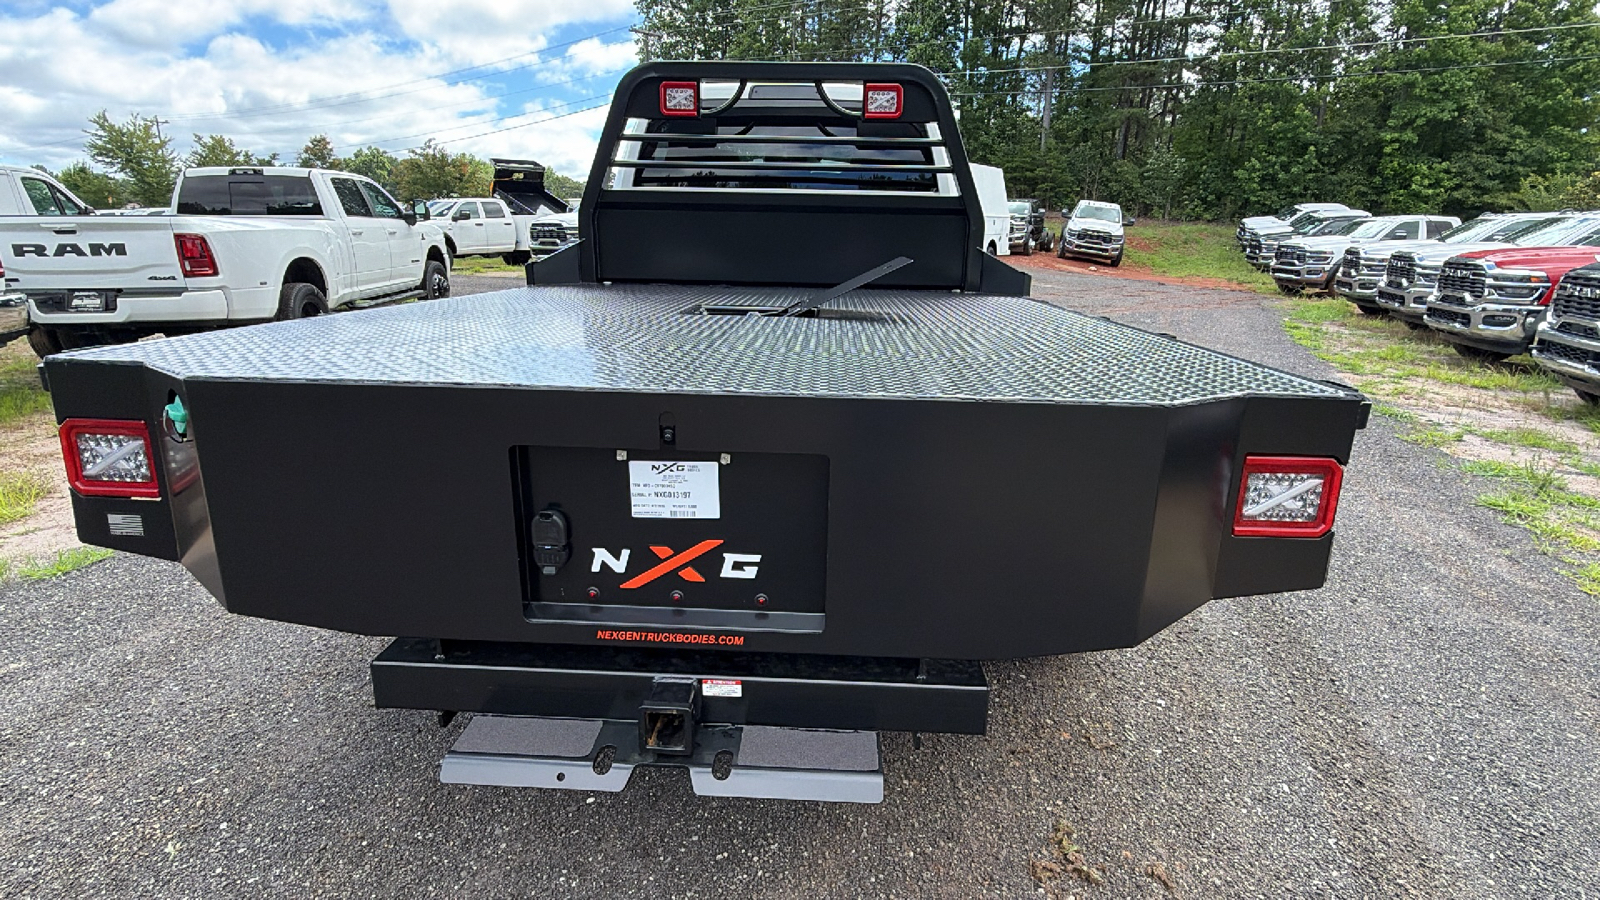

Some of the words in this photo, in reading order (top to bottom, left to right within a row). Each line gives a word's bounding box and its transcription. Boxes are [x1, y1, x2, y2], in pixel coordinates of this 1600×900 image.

[11, 243, 128, 258] RAM
[651, 462, 686, 475] NXG
[590, 539, 763, 590] NXG
[596, 629, 746, 646] NEXGENTRUCKBODIES.COM
